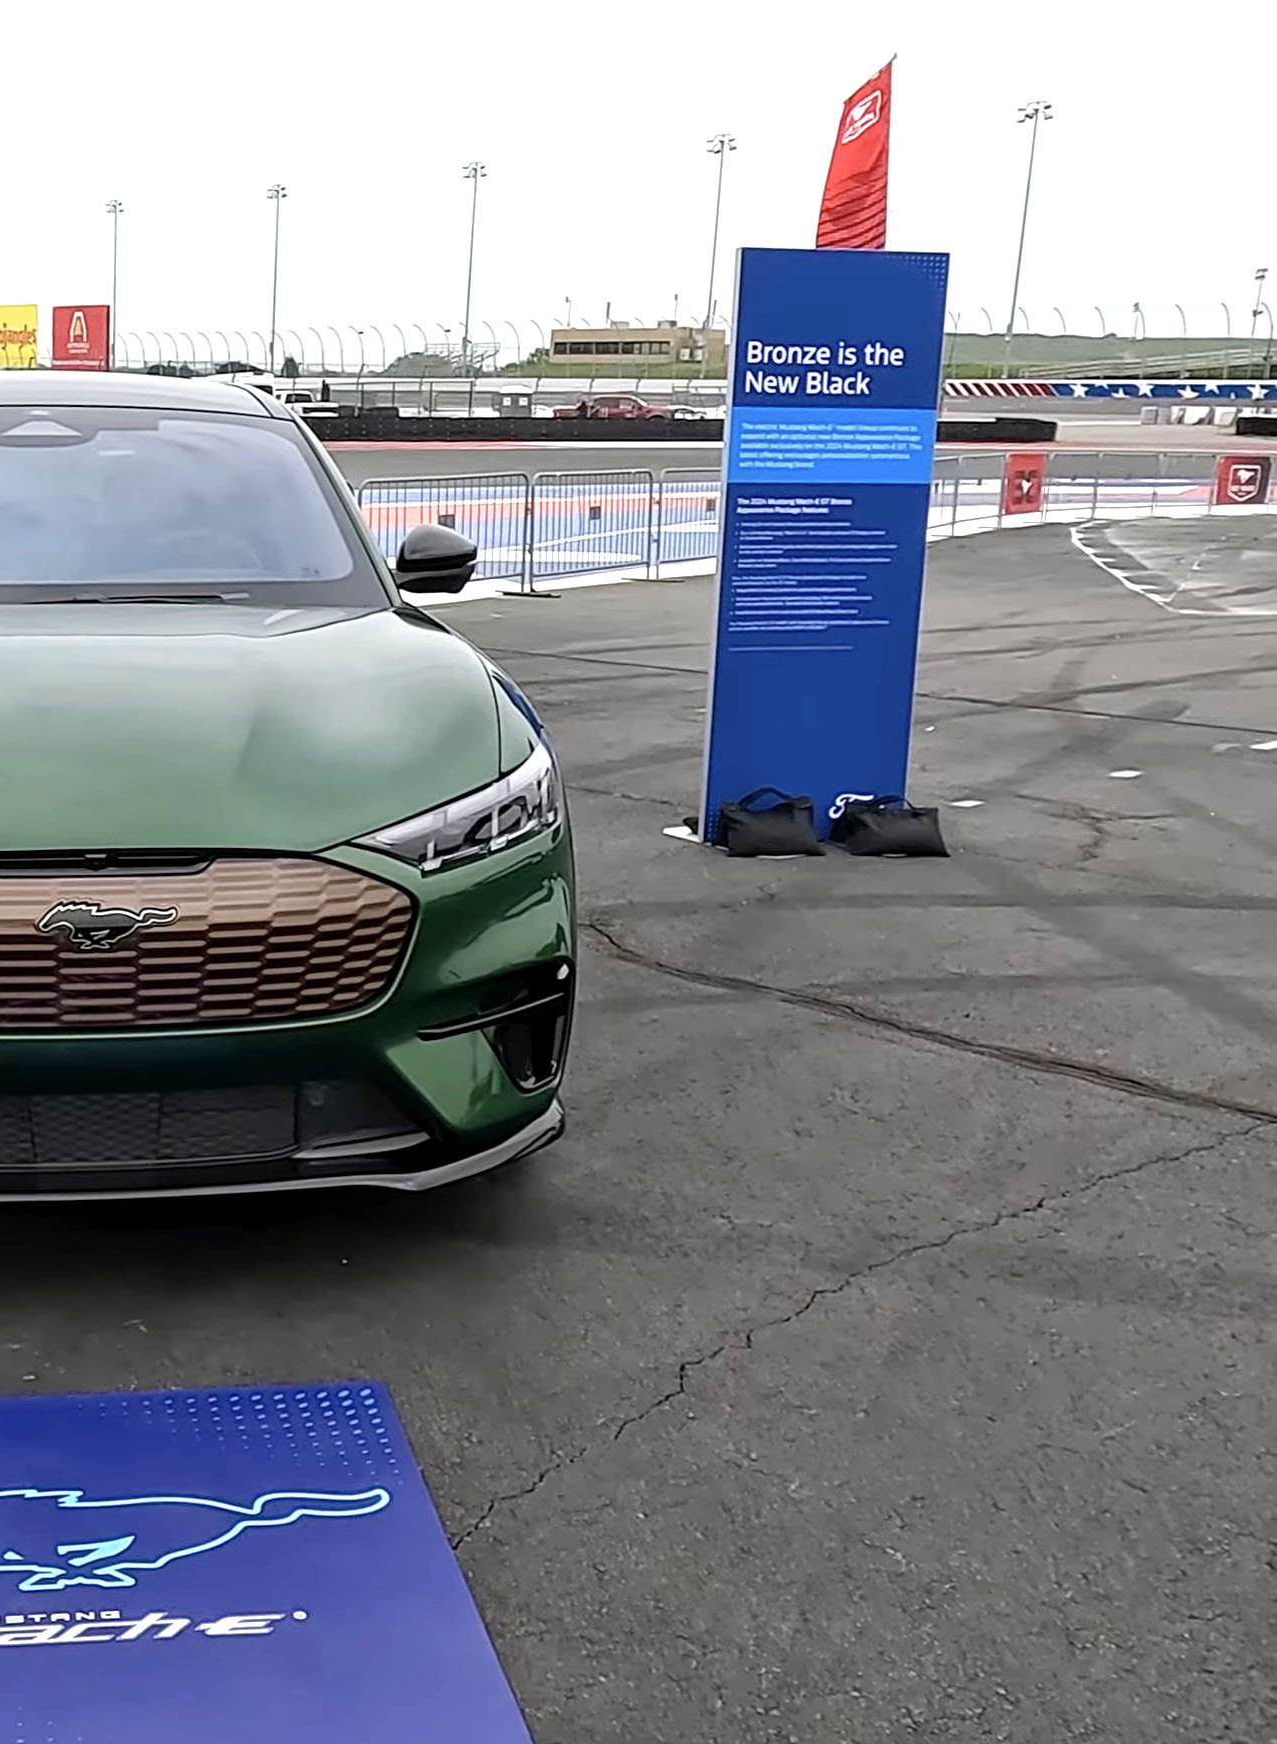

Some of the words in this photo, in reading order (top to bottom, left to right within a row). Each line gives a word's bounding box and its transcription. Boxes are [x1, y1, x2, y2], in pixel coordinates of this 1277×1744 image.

[746, 340, 831, 365] Bronze
[837, 341, 857, 366] is
[864, 342, 904, 366] the
[744, 370, 800, 394] New
[805, 371, 871, 395] Black
